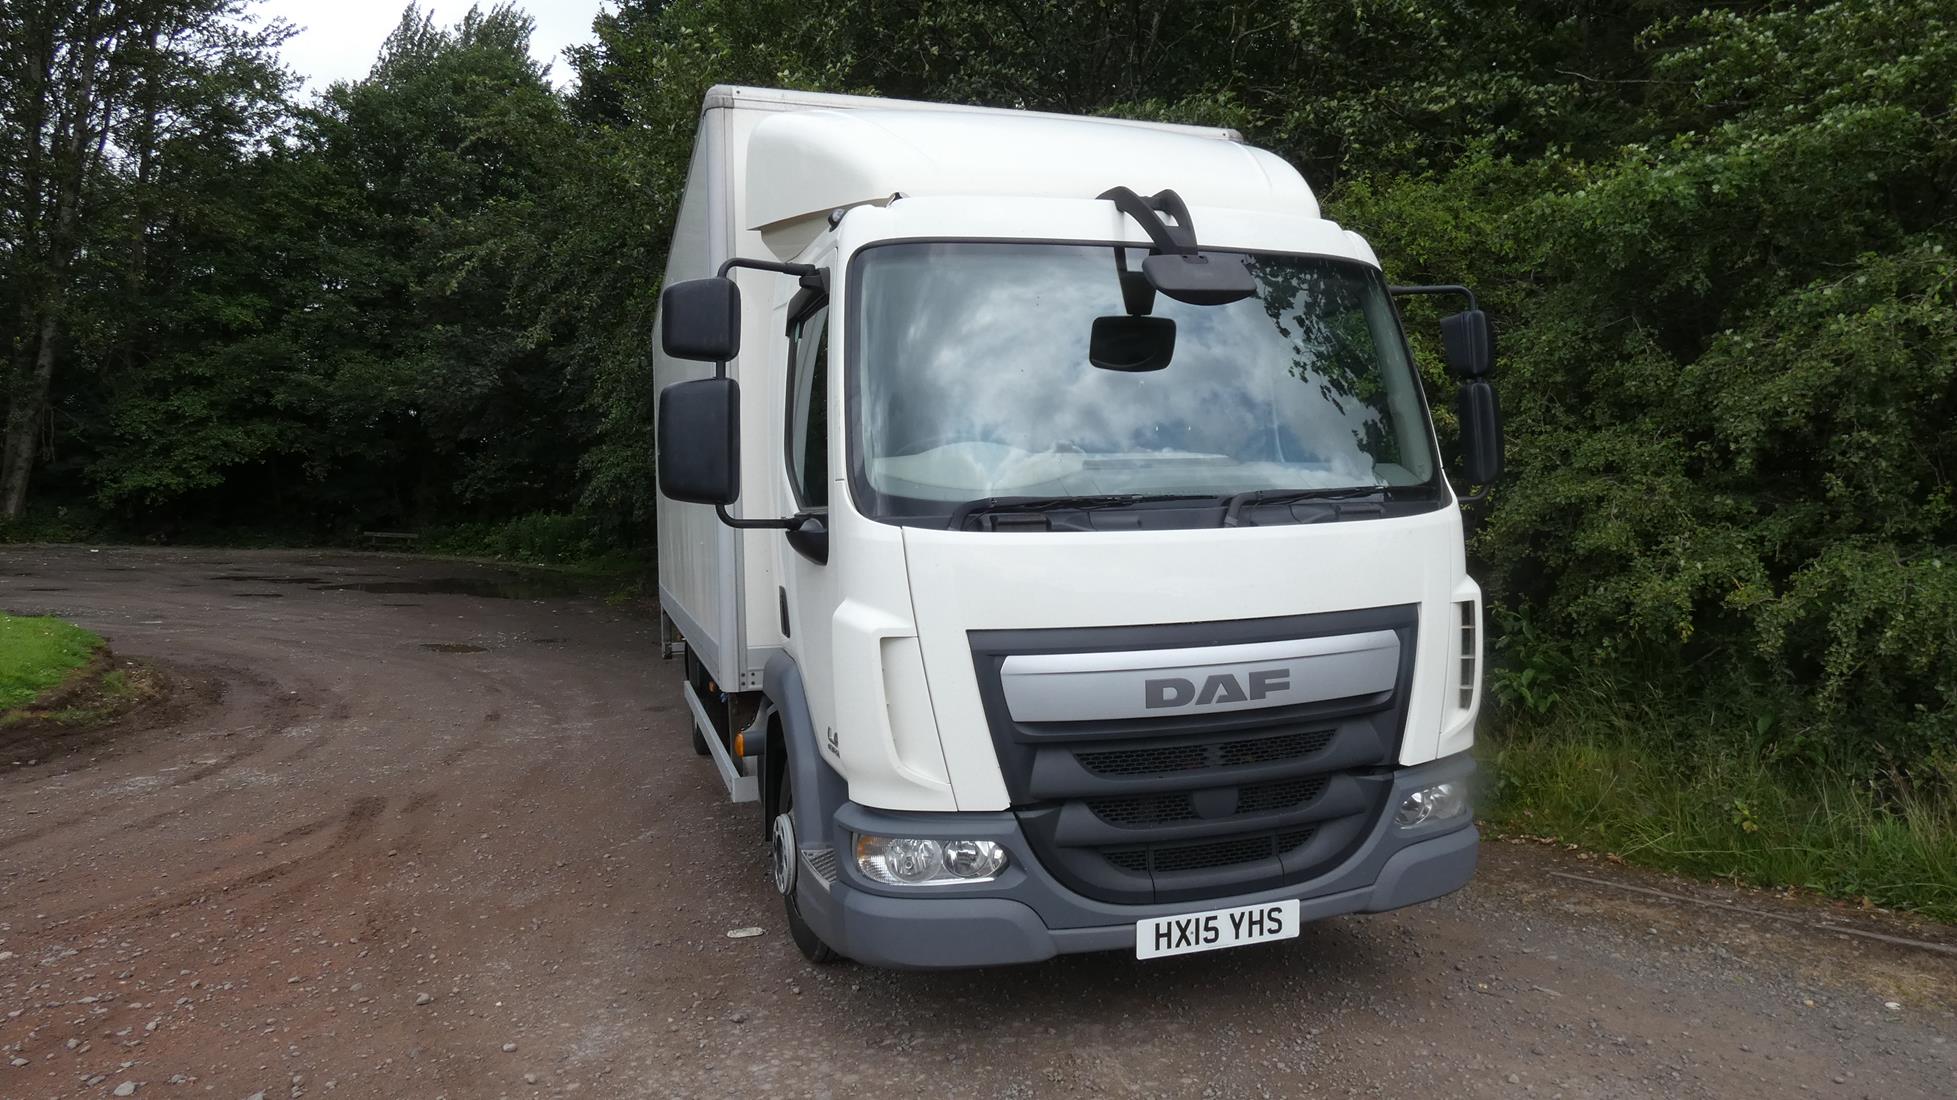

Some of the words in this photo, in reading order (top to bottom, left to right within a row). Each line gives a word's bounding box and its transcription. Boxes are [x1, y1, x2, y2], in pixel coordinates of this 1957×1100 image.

[1145, 668, 1290, 709] DAF
[1155, 915, 1220, 951] HX15
[1229, 907, 1283, 939] YHS
